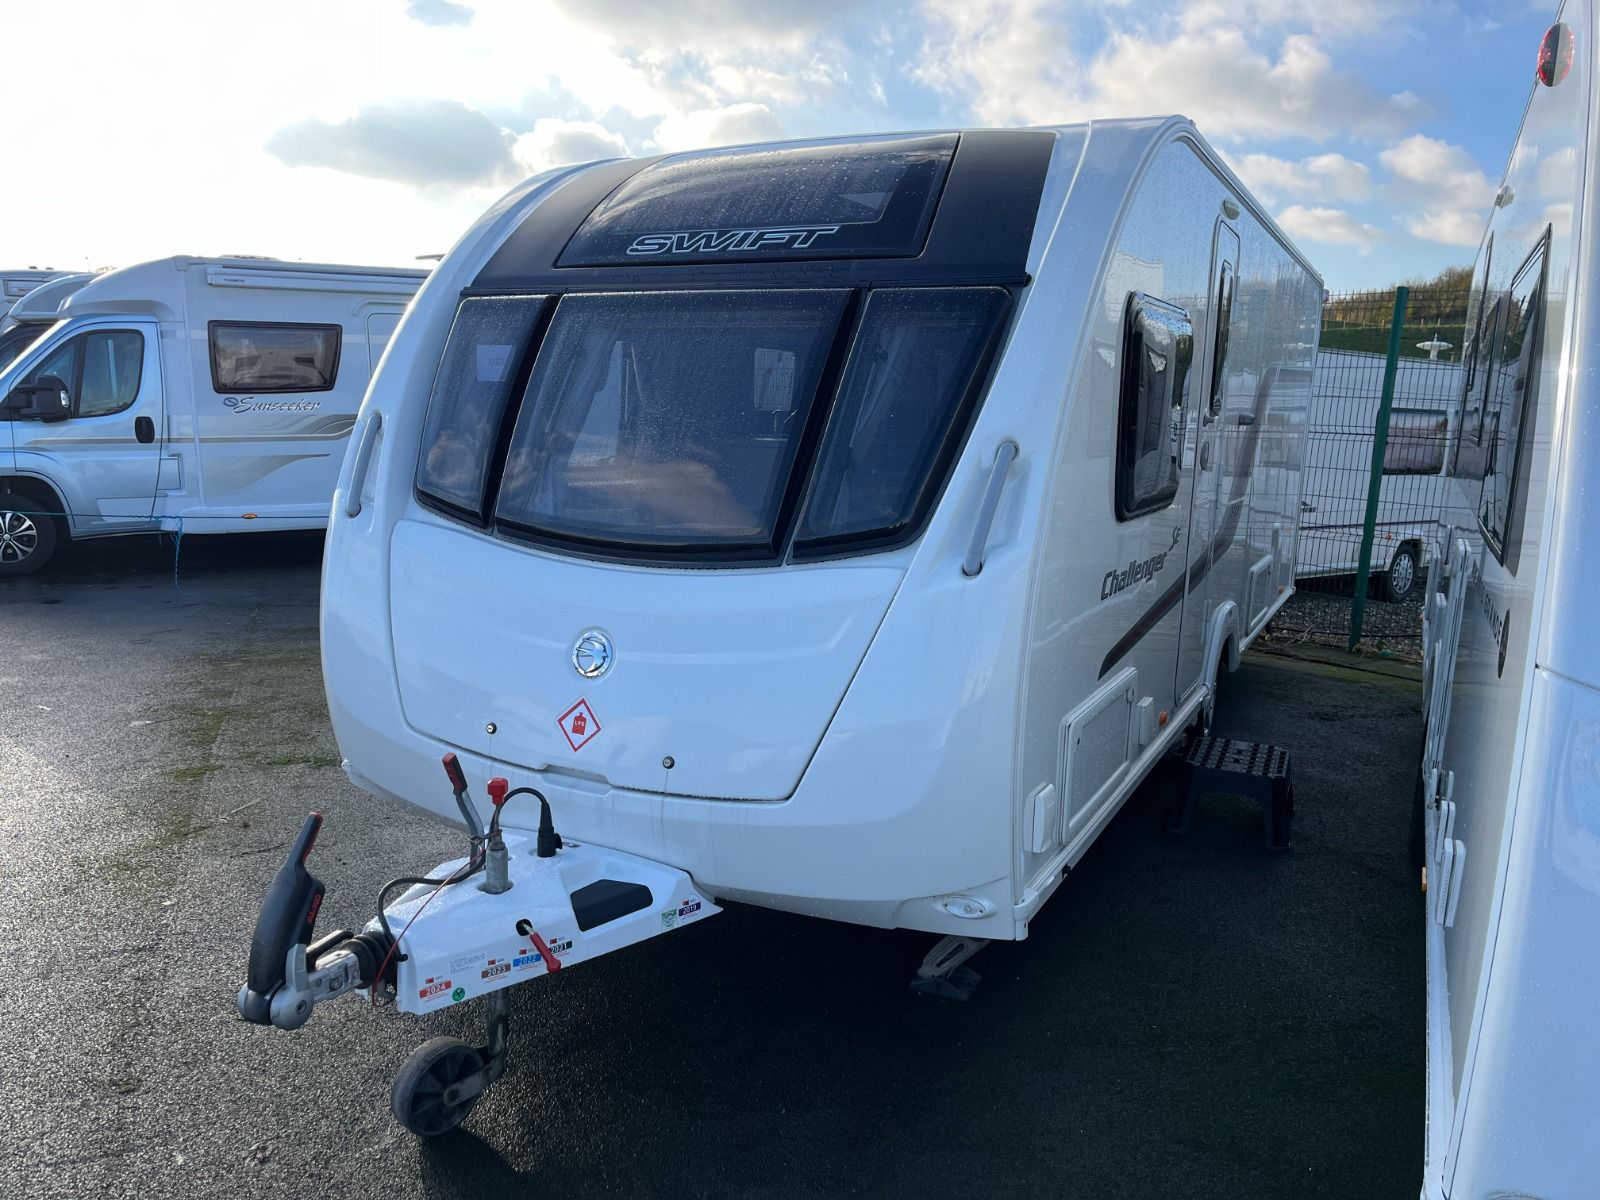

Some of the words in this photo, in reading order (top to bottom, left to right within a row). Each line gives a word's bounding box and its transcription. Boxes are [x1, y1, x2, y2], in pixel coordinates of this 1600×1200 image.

[626, 225, 841, 255] SWIFT
[233, 396, 321, 414] Sunseeker
[1100, 551, 1168, 601] Challenger
[519, 954, 537, 966] 2022
[487, 965, 507, 977] 2023
[425, 983, 446, 995] 2024
